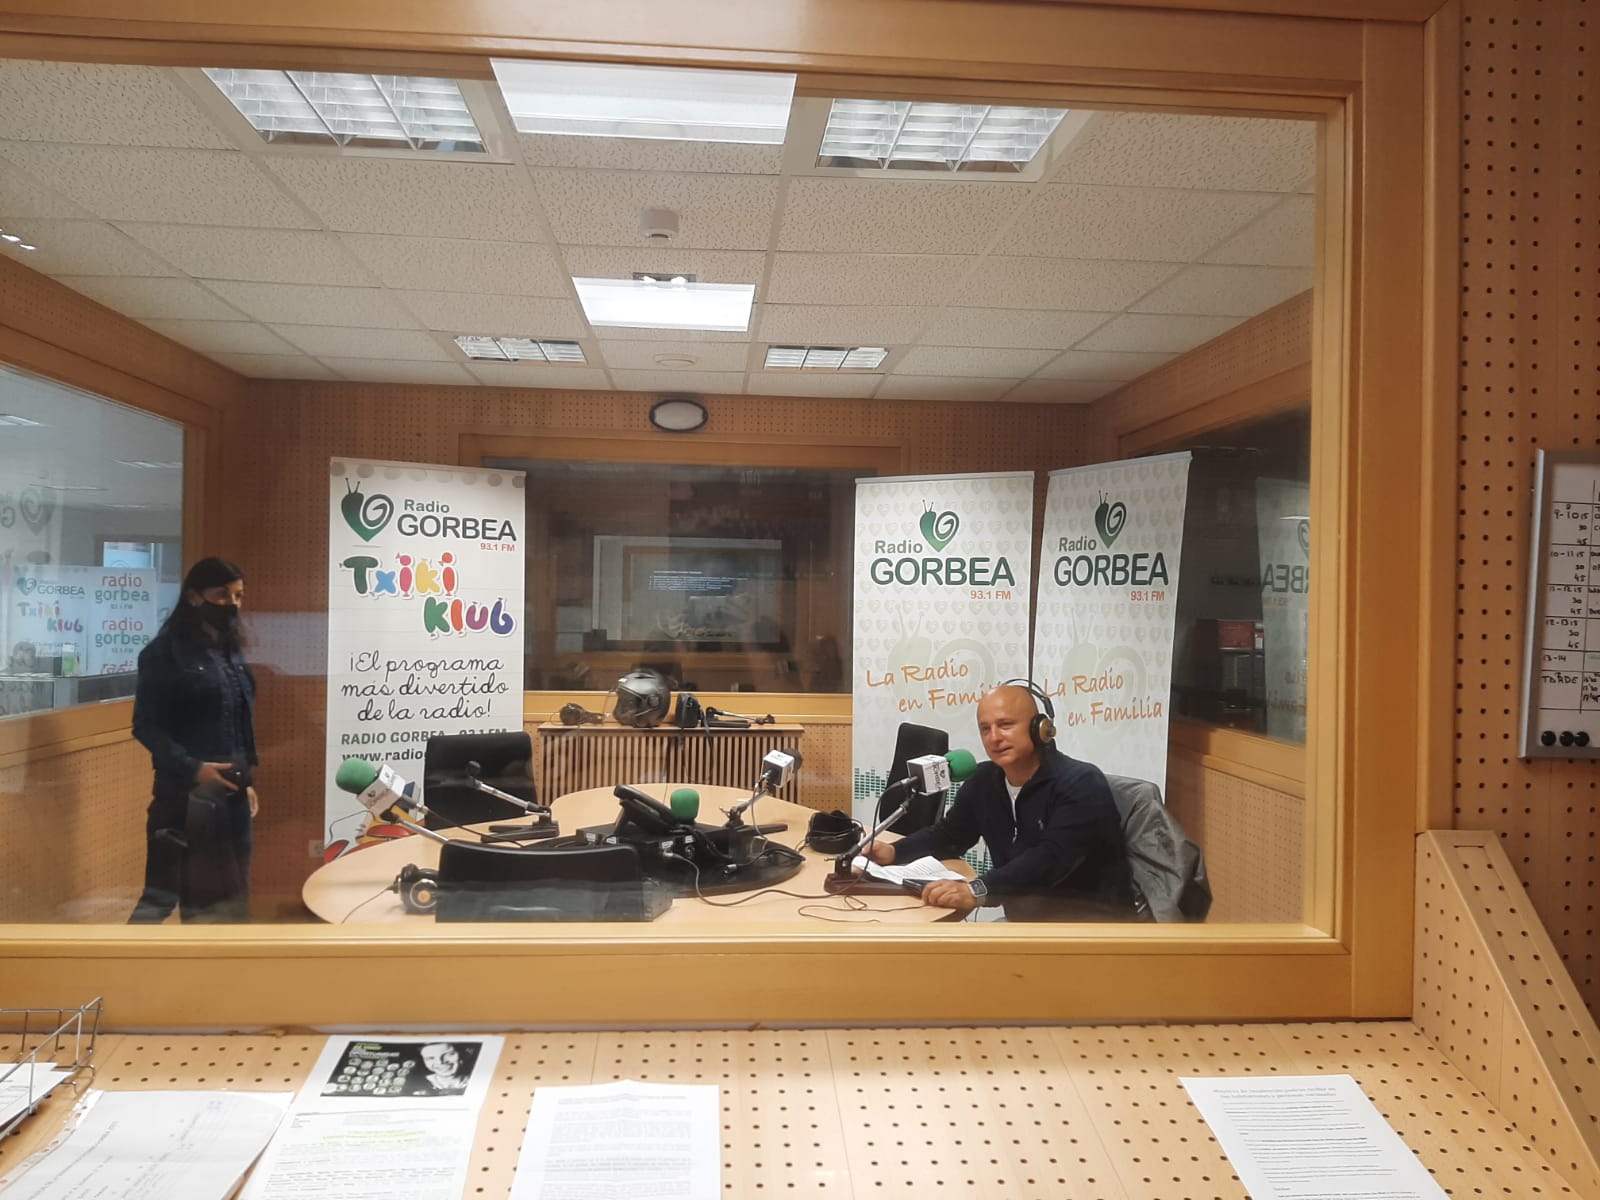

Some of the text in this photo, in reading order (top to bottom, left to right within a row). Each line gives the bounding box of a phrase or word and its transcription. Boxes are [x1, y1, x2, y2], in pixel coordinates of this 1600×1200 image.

[404, 499, 450, 513] Radio
[397, 514, 517, 541] GORBEA
[480, 543, 515, 552] 93.1 FM
[875, 540, 923, 553] Radio
[1058, 536, 1097, 552] Radio
[341, 552, 456, 596] Txiki
[870, 557, 1015, 586] GORBEA
[1054, 552, 1169, 586] GORBEA
[102, 572, 142, 587] radio
[95, 587, 149, 604] gorbea
[970, 590, 1011, 600] 93.1 FM
[1131, 591, 1164, 601] 93.1 FM
[102, 616, 144, 631] radio
[95, 631, 151, 648] gorbea
[101, 660, 136, 674] radi
[385, 657, 504, 682] programa
[867, 658, 968, 687] La Radio
[341, 673, 509, 697] más divertido
[1044, 667, 1123, 697] La Radio
[357, 697, 491, 721] de la radio!
[899, 698, 923, 712] en
[1068, 696, 1162, 727] en Familia
[341, 732, 386, 745] RADIO
